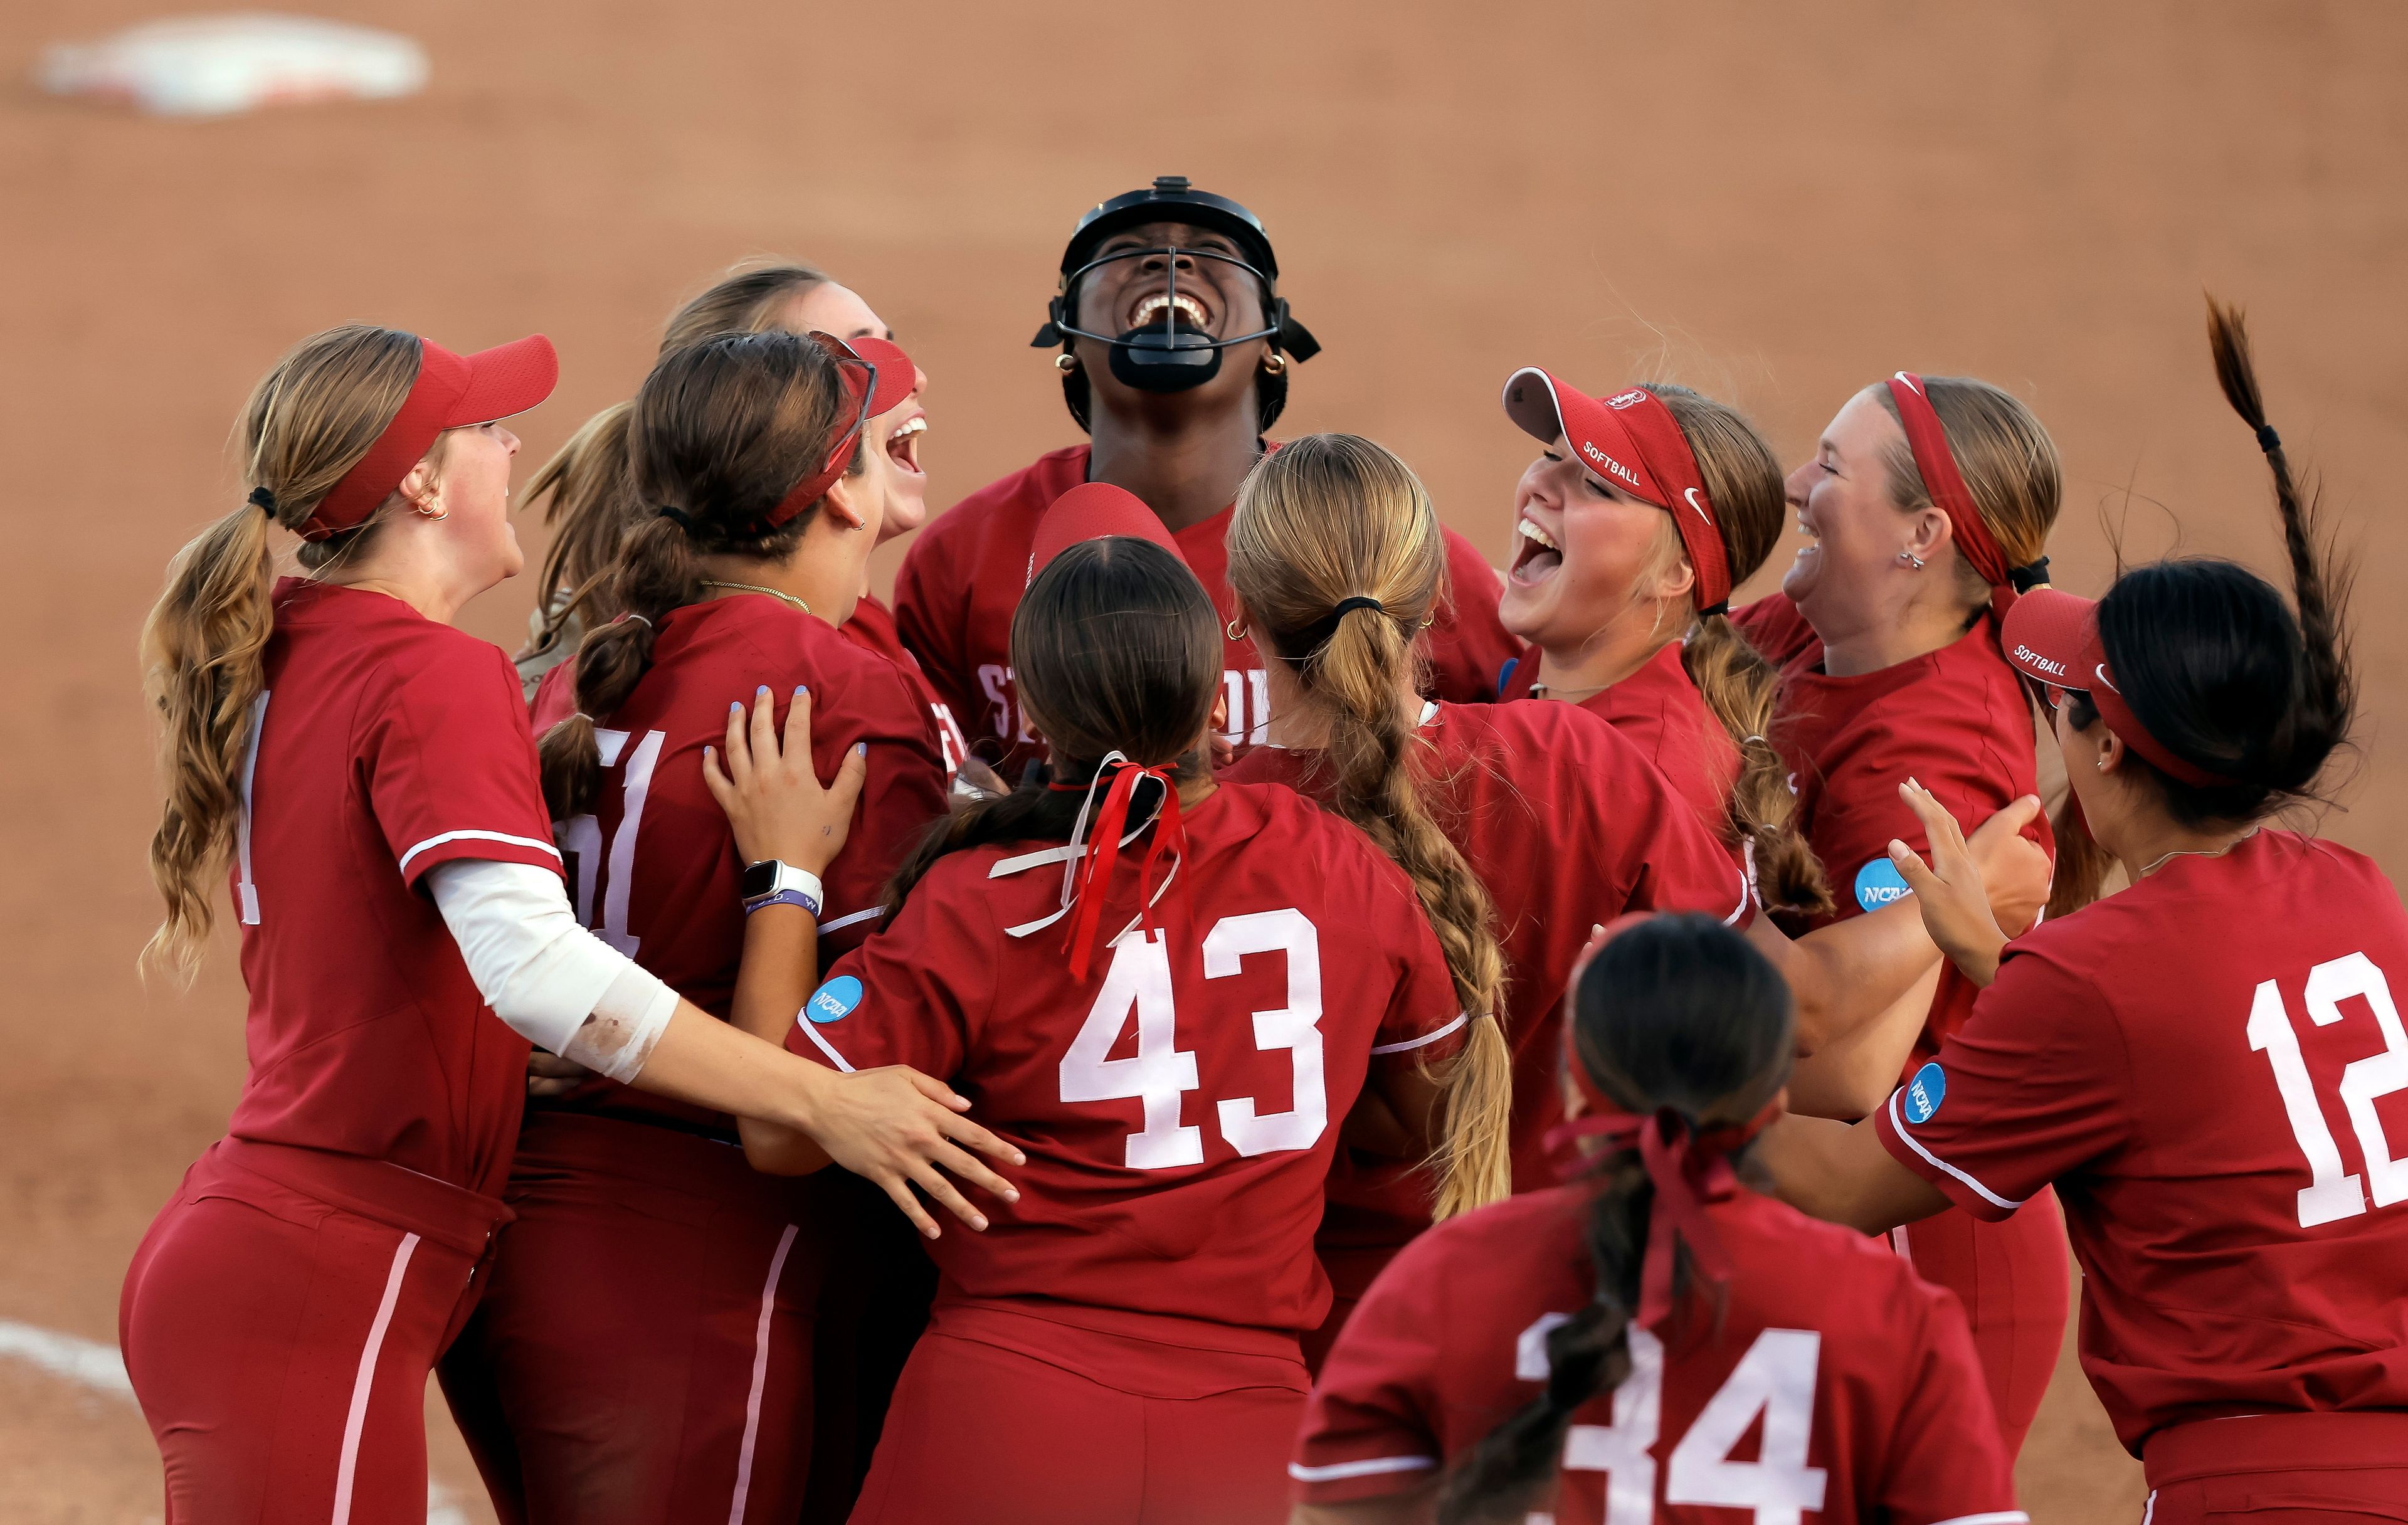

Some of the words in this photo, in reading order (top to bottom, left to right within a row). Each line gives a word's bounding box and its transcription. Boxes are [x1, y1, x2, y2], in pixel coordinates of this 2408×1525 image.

[1583, 440, 1640, 487] SOFTBALL
[2014, 644, 2067, 677] SOFTBALL
[1864, 887, 1908, 902] NCA
[814, 992, 848, 1017] NCAA
[1059, 907, 1328, 1169] 43
[1911, 1080, 1933, 1121] NCAA
[2246, 951, 2408, 1228] 12
[1516, 1312, 1827, 1525] 34
